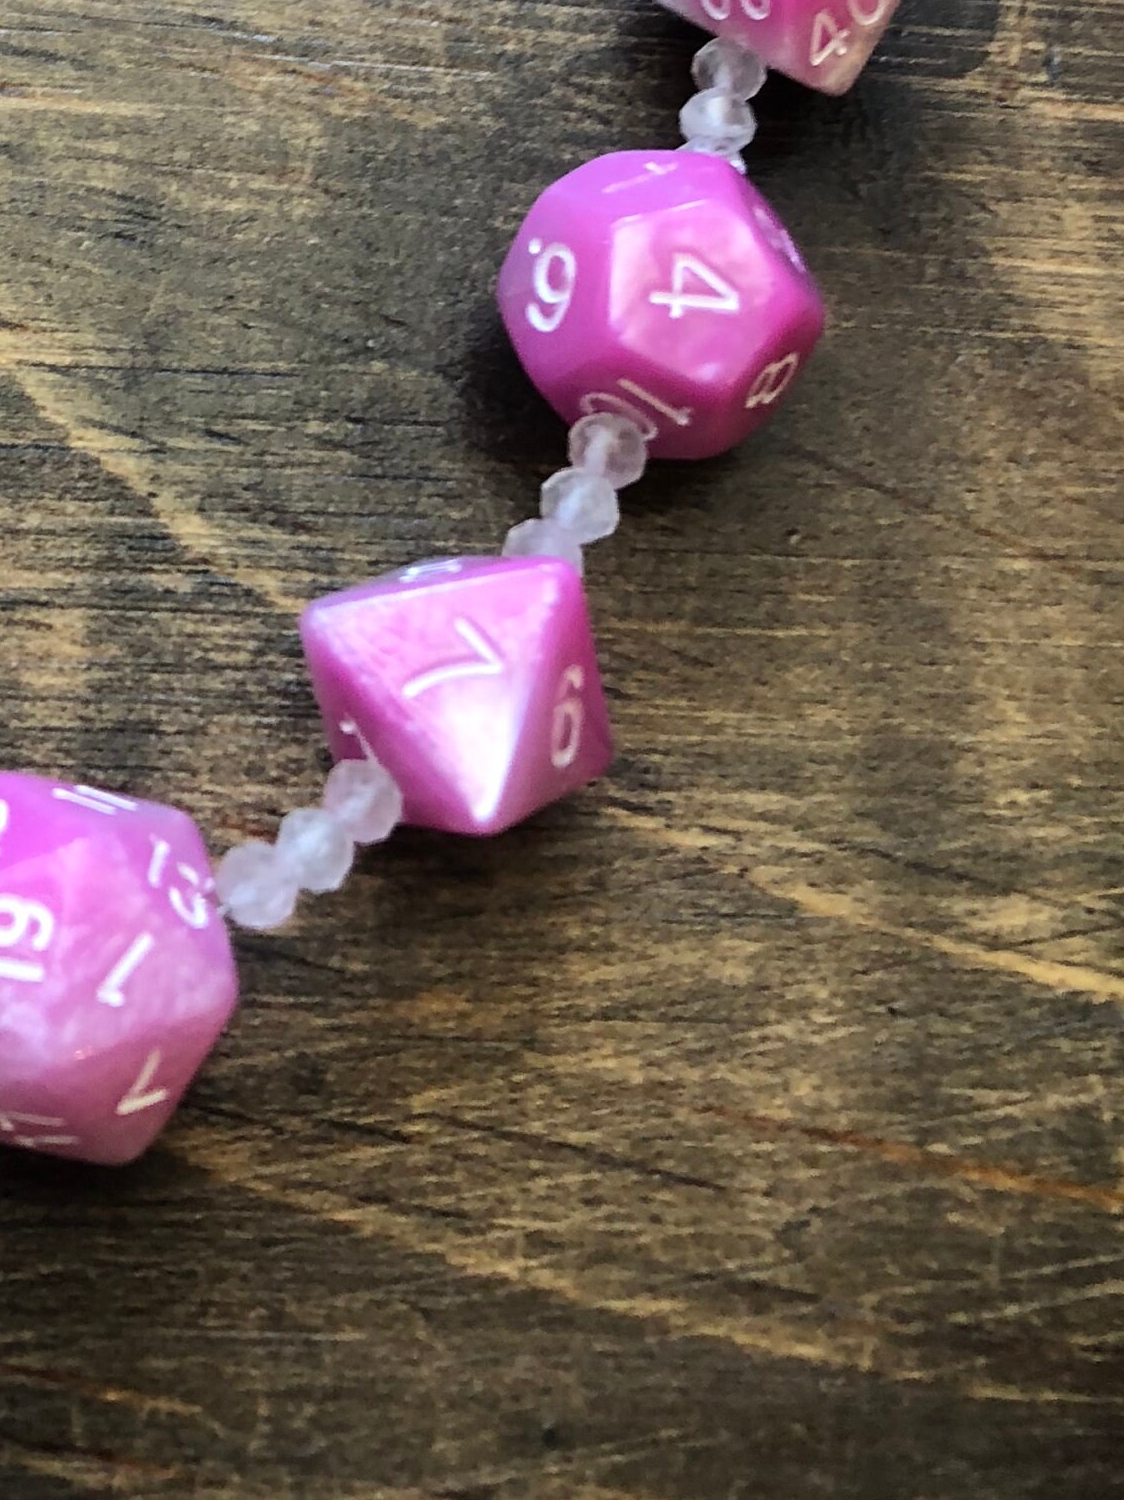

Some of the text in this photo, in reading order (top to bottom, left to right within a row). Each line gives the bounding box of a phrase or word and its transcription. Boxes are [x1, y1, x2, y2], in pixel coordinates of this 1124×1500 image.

[648, 253, 740, 320] 4
[402, 615, 504, 700] 7
[96, 931, 155, 1007] 1
[116, 1050, 167, 1116] 7
